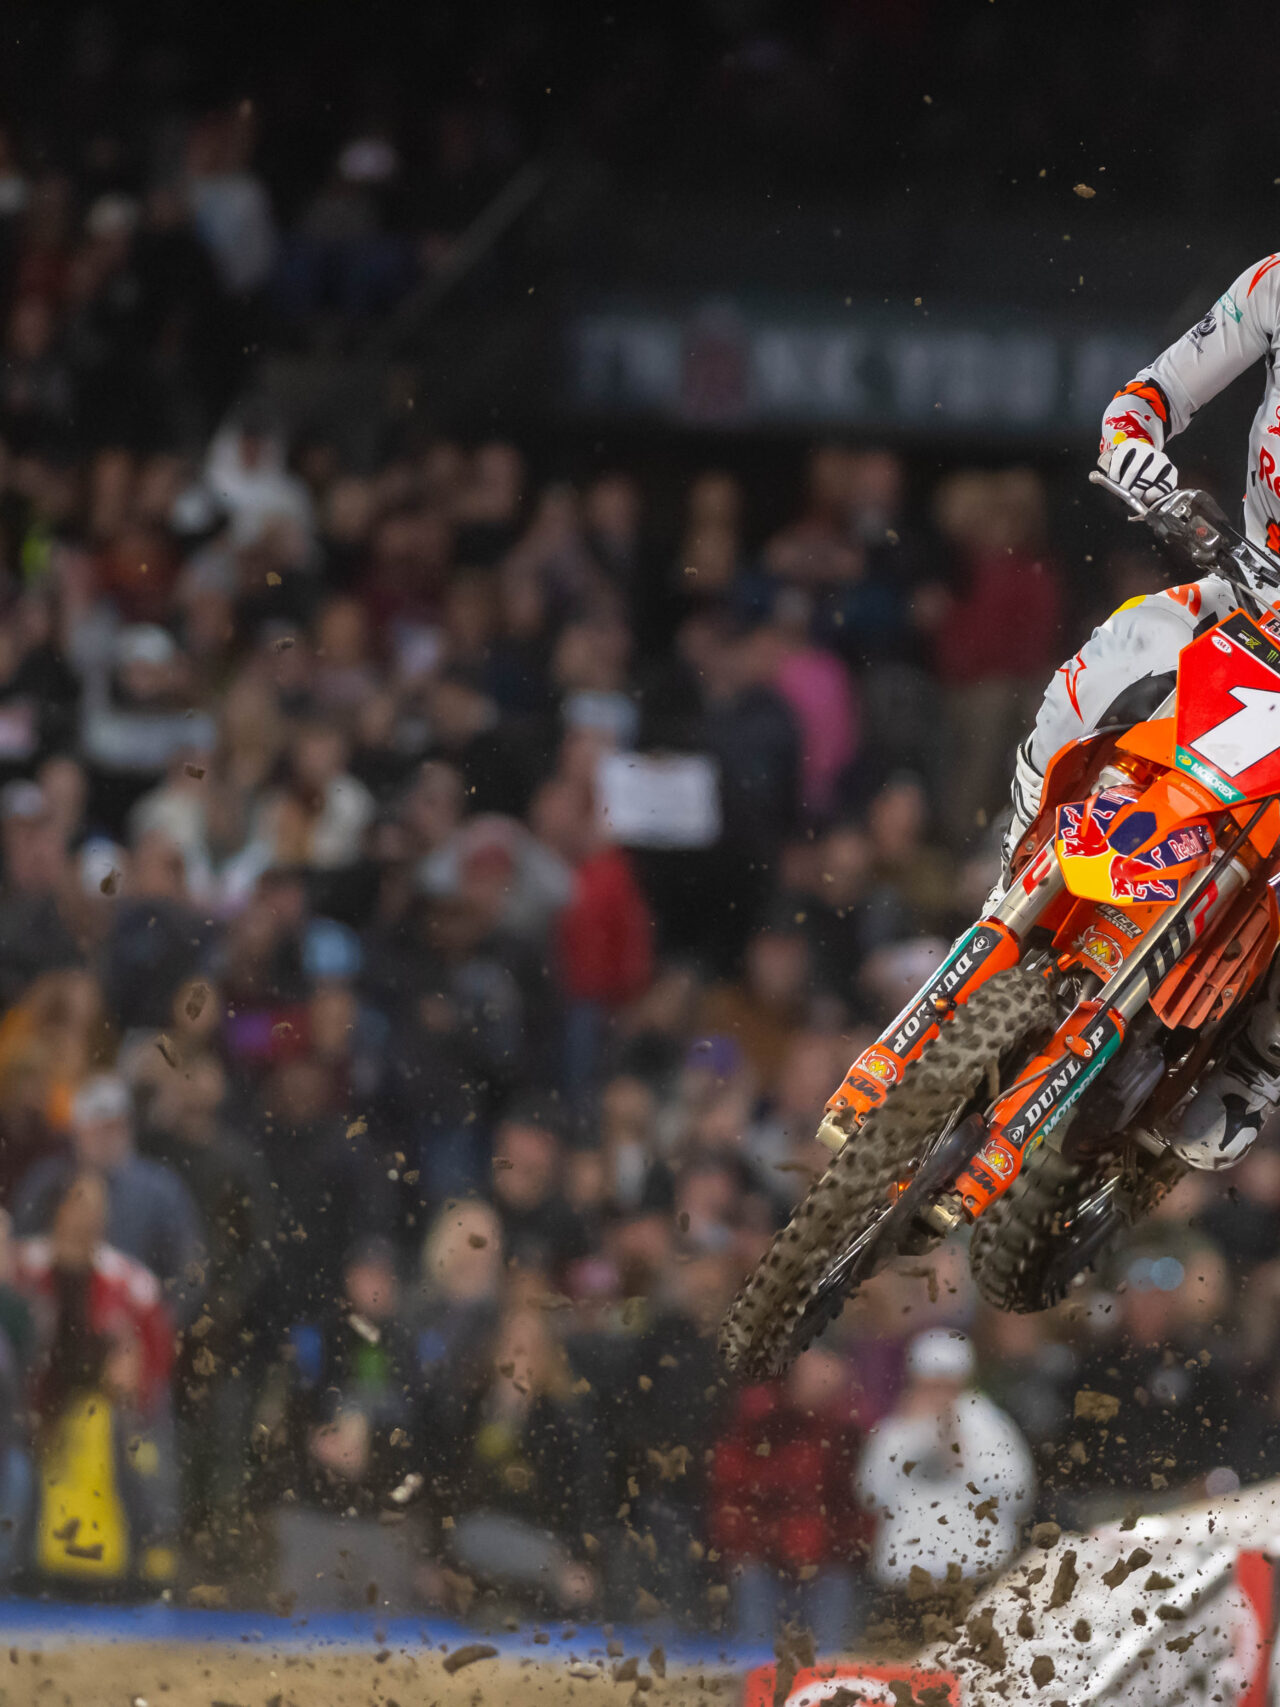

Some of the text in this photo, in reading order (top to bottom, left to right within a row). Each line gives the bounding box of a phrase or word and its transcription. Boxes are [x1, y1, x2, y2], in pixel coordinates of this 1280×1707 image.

[1190, 763, 1238, 801] MOTOREX
[1024, 1025, 1105, 1128] DUNLP
[1043, 1056, 1107, 1136] MOTOREX
